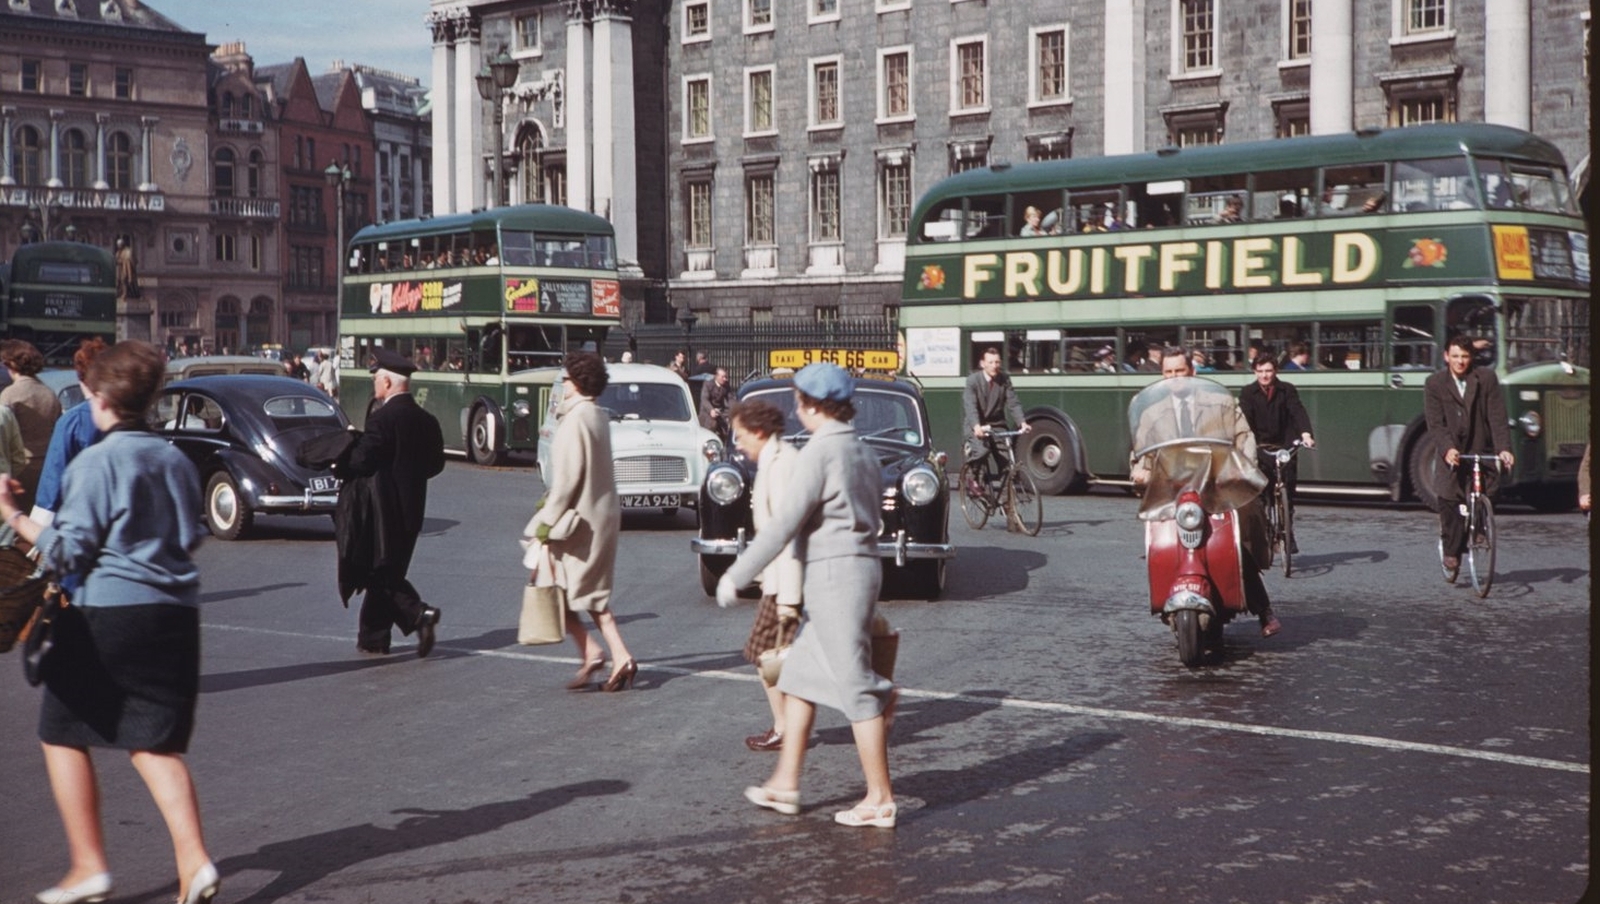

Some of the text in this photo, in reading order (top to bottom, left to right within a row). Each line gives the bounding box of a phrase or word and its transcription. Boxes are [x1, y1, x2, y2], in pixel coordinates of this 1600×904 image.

[963, 232, 1379, 298] FRUITFIELD
[541, 281, 586, 292] SALLYNOGGIN
[605, 304, 620, 315] TEA
[775, 350, 889, 368] TAXI 9 66 66 CAB
[624, 494, 679, 507] WZA 943
